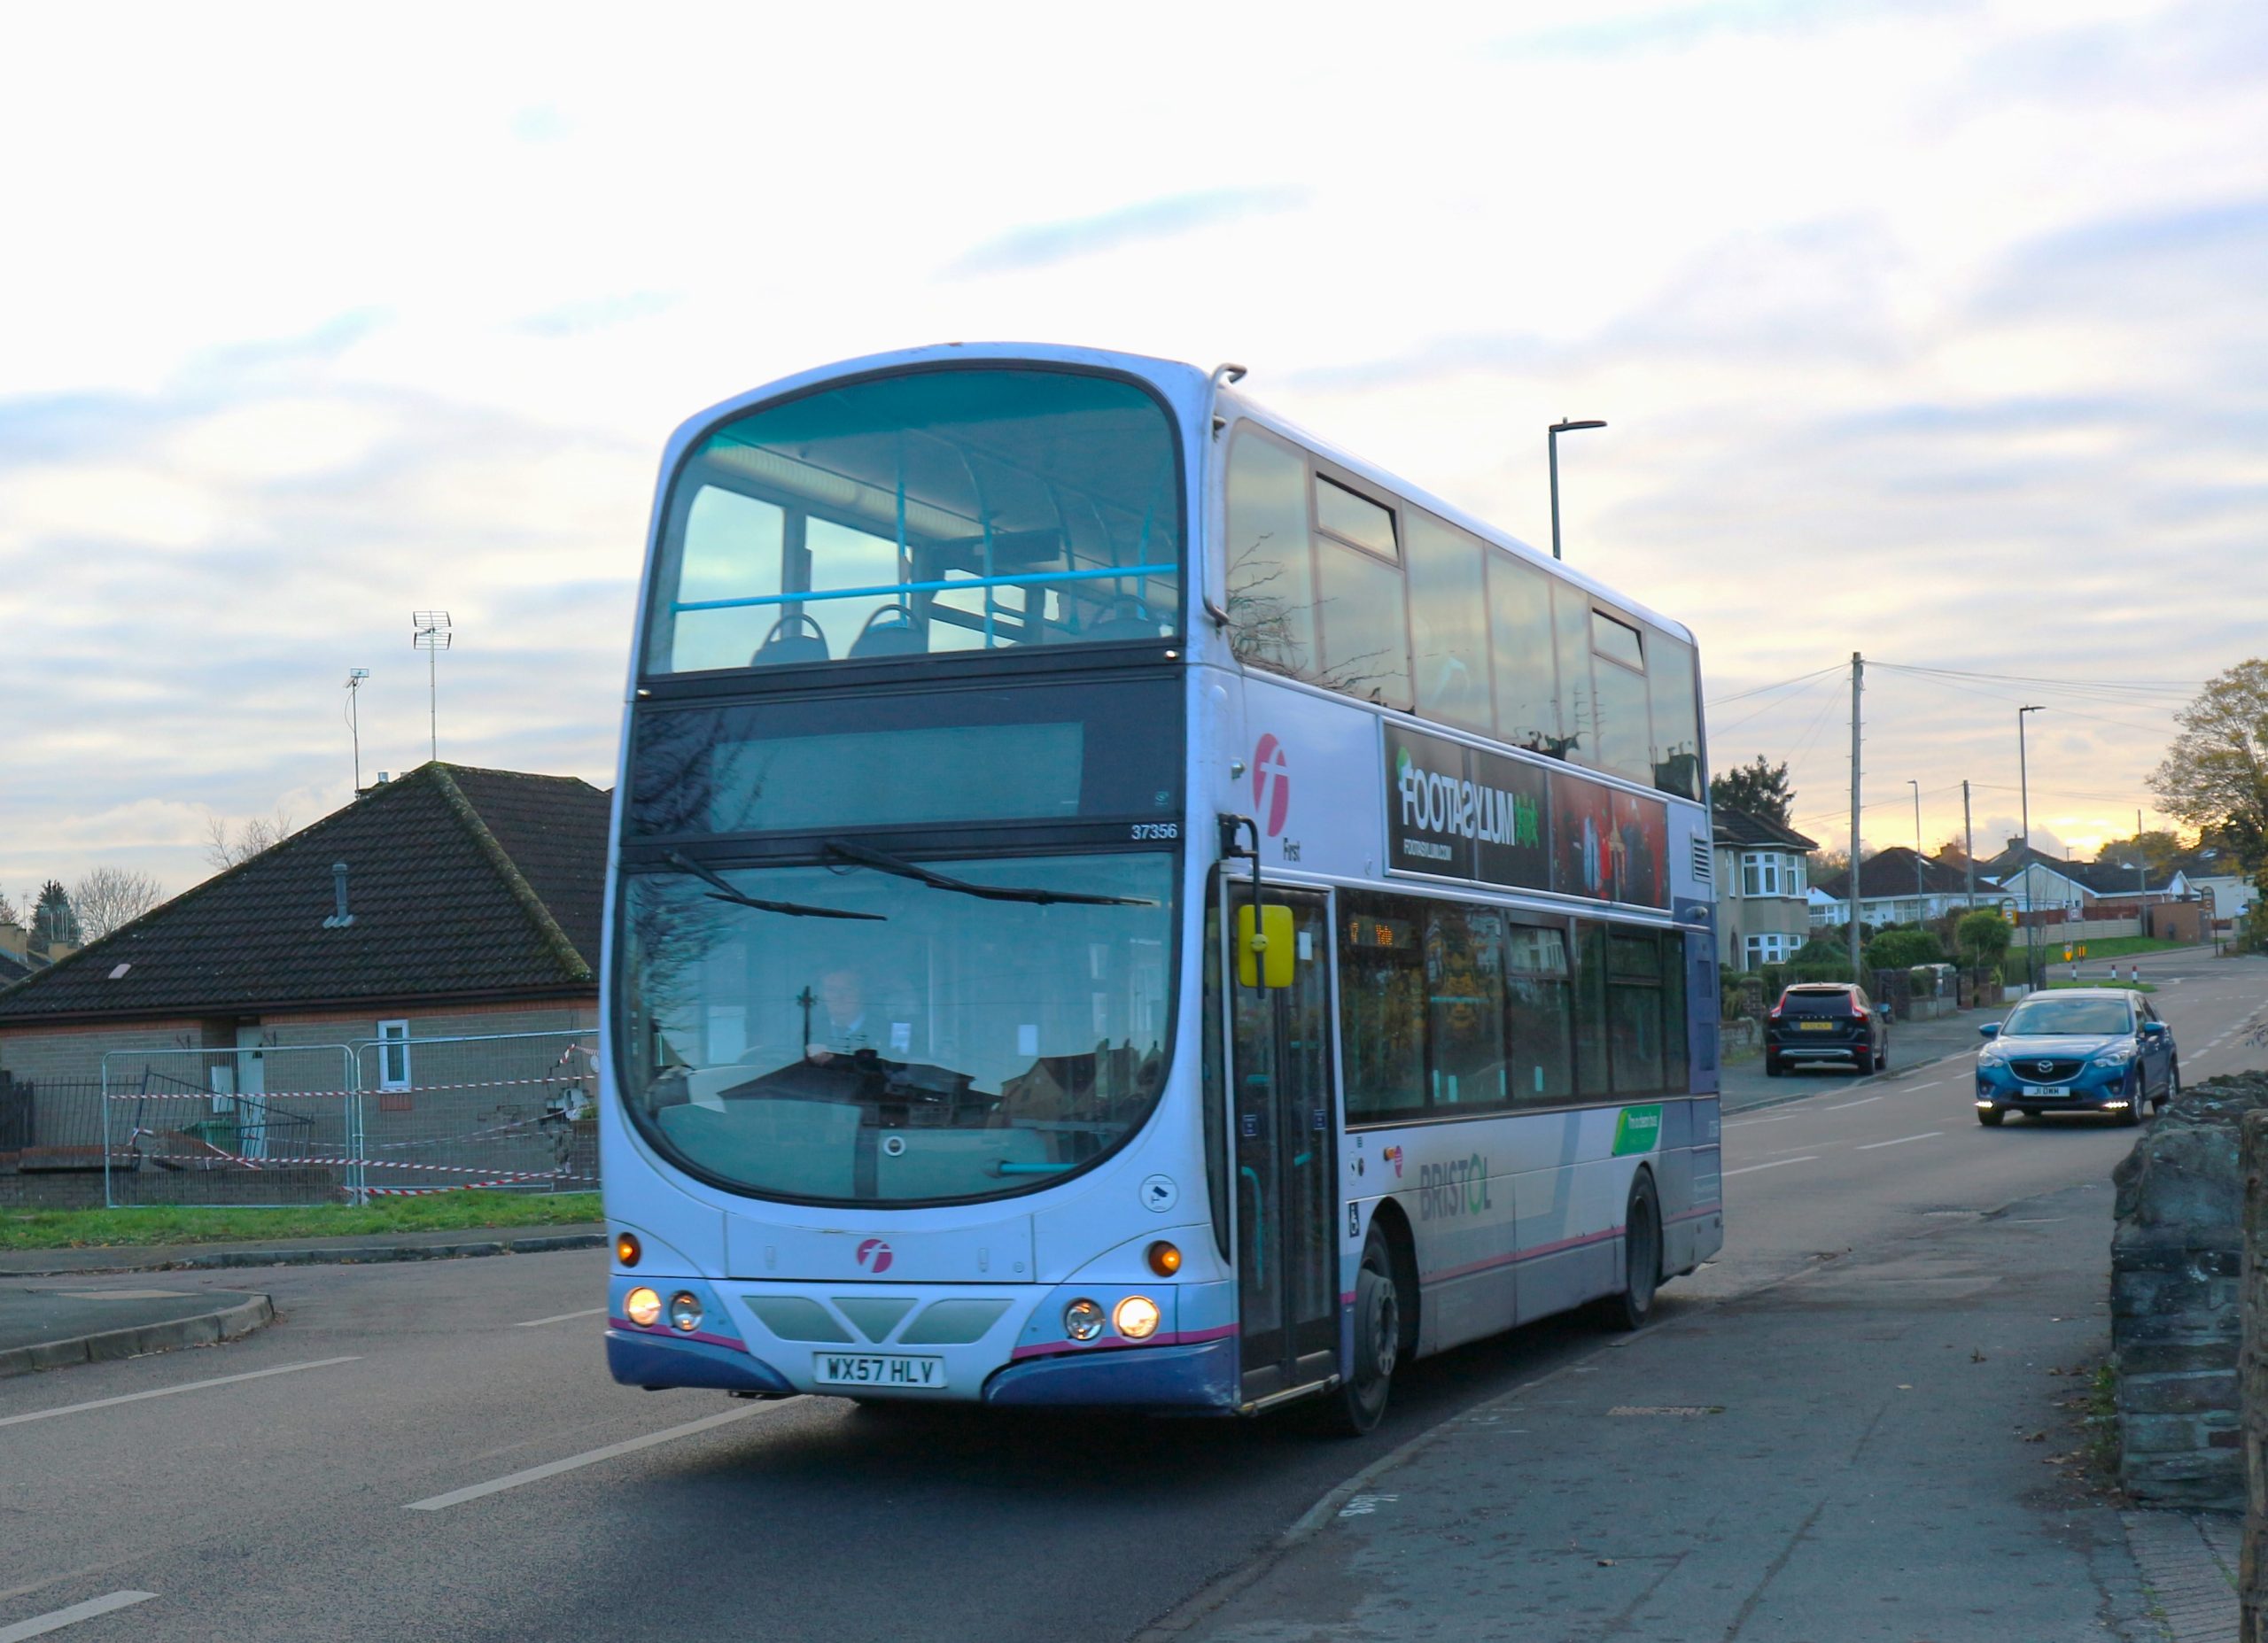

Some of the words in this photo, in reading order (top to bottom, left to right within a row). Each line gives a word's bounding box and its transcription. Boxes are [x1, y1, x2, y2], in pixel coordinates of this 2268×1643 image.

[1399, 766, 1515, 846] FOOTASYLUM
[1131, 823, 1178, 840] 37356
[1282, 837, 1301, 862] First
[1420, 1153, 1491, 1221] BRISTOL
[827, 1358, 884, 1381] WX57
[891, 1360, 933, 1383] HLV
